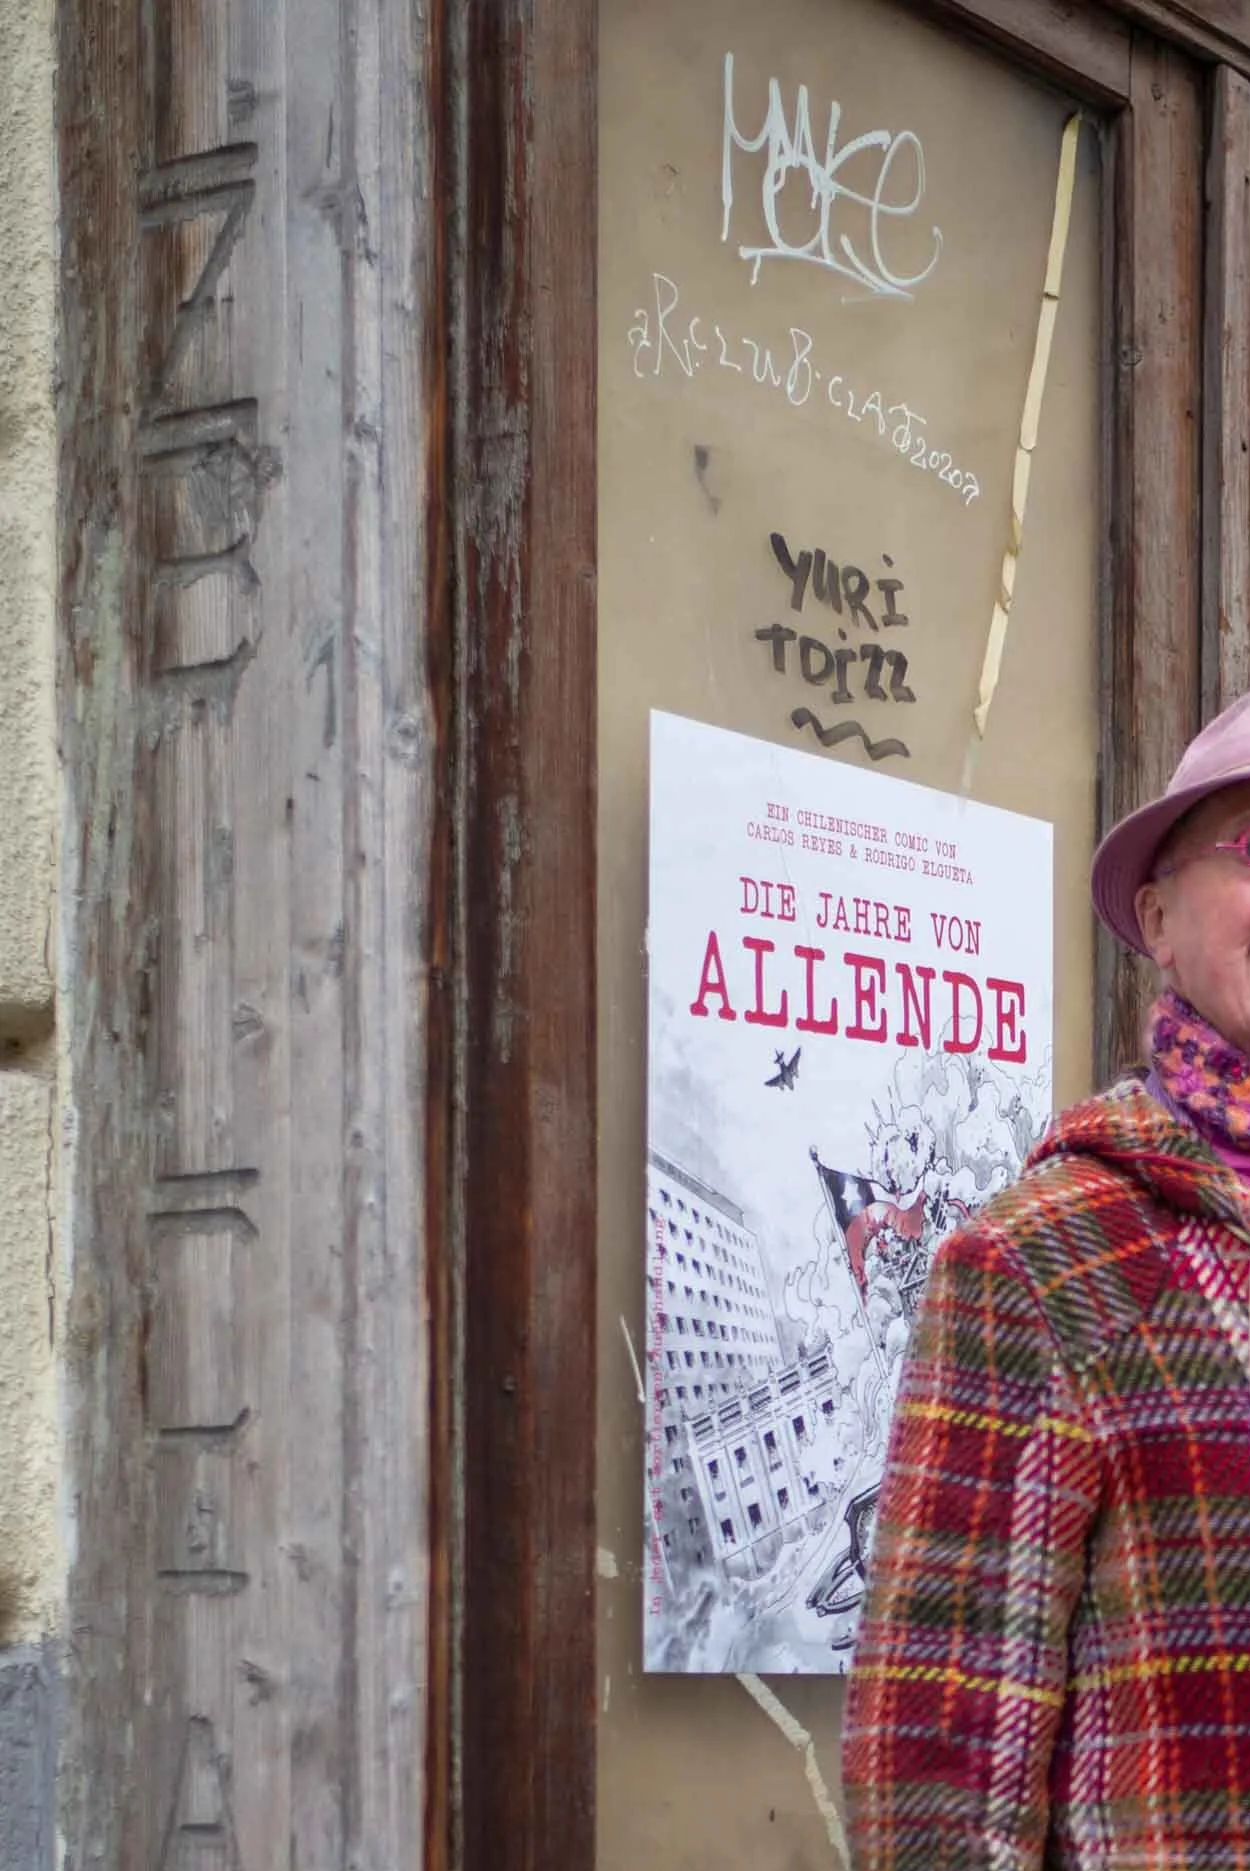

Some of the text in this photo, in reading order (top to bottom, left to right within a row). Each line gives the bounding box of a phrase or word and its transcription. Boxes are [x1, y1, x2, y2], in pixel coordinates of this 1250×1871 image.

[746, 821, 975, 886] CARLOS REYES & RODRIGO ELGUETA
[767, 802, 957, 860] EIN CHILENISCHER COMIC VON
[739, 875, 982, 956] DIE JAHRE VON
[689, 929, 1027, 1065] ALLENDE
